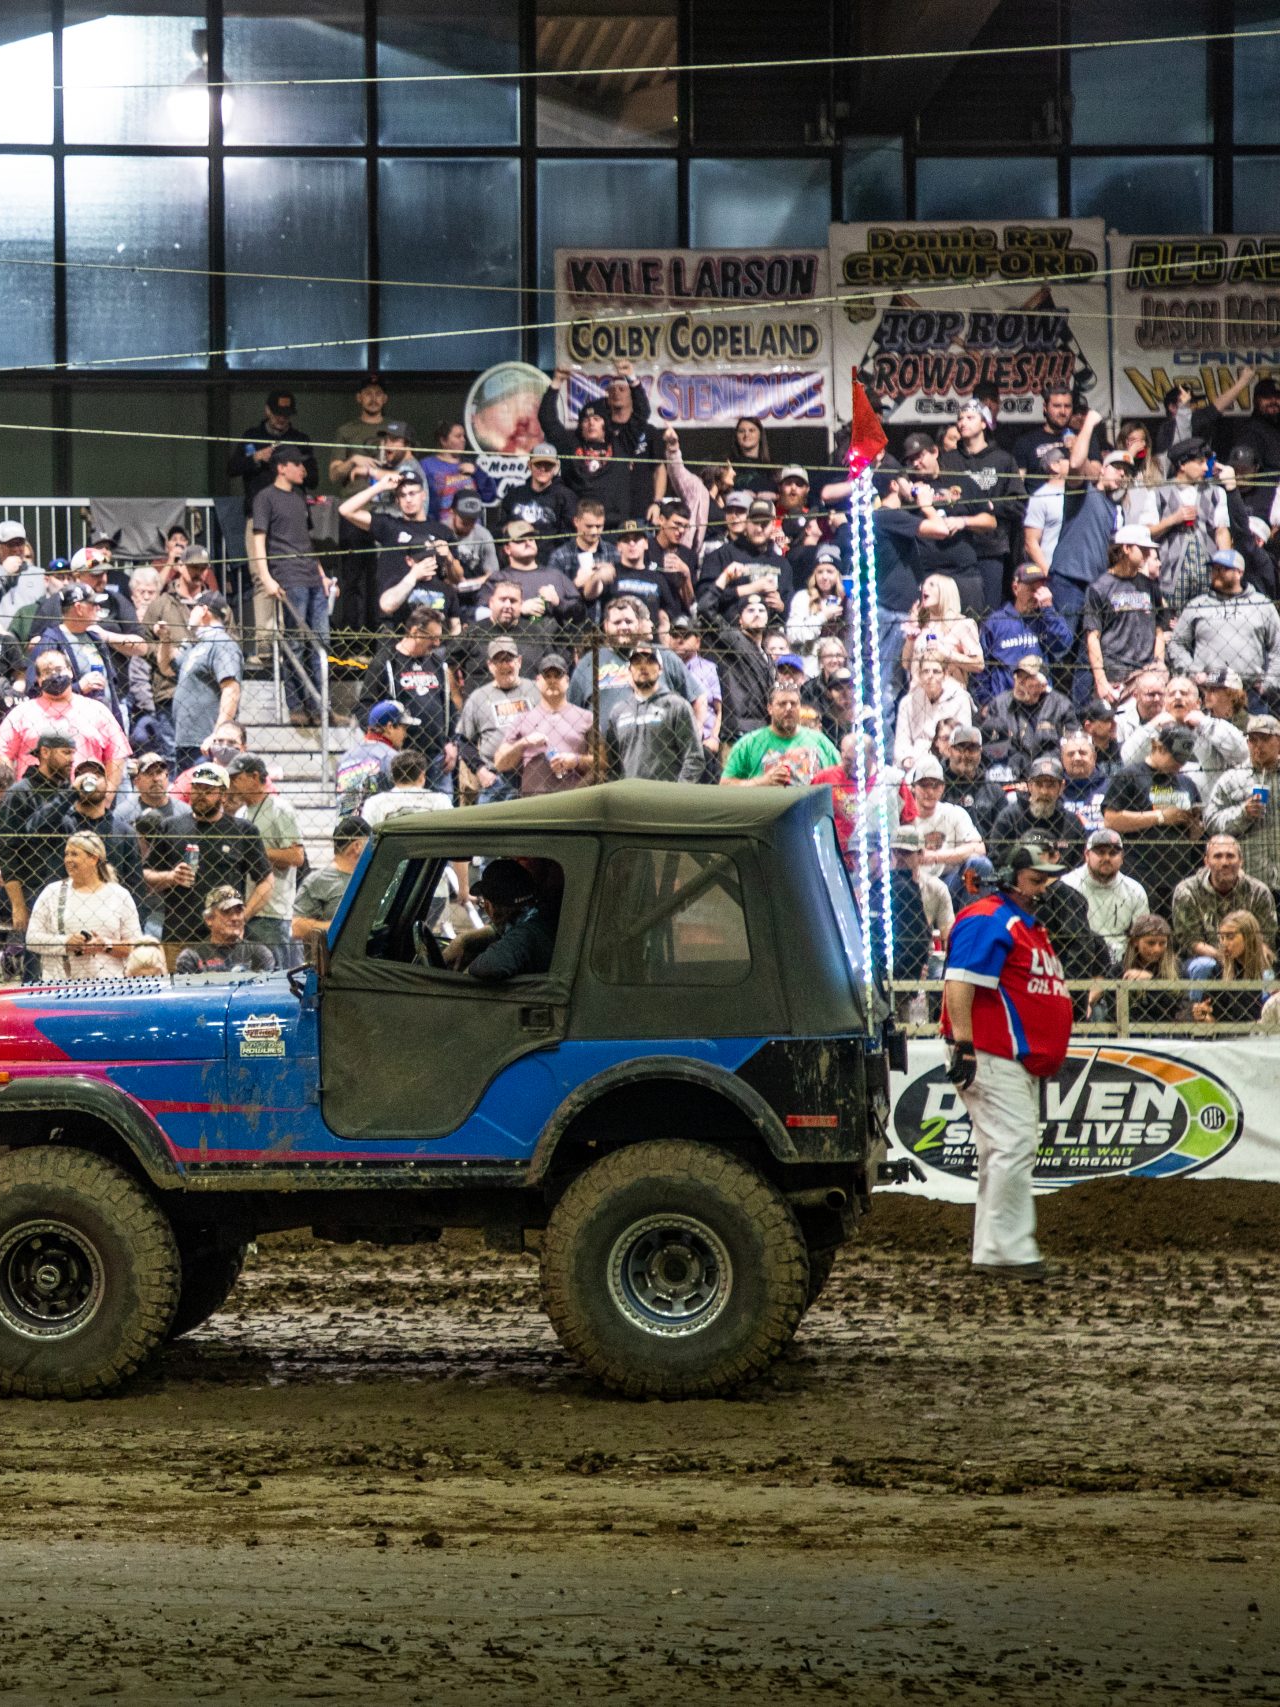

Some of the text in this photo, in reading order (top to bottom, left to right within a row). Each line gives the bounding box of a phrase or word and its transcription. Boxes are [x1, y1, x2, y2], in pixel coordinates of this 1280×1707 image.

[868, 226, 1073, 251] Donnie Ray
[568, 255, 820, 301] KYLE LARSON
[843, 250, 1099, 285] CRAWFORD
[1128, 240, 1227, 290] RICO
[569, 312, 821, 363] COLBY COPELAND
[882, 308, 1069, 350] TOP ROW
[1135, 295, 1221, 350] JASON
[657, 371, 826, 421] STENHOUSE
[921, 1081, 1180, 1121] DVEN
[943, 1146, 1135, 1157] RACI ND THE WAIT
[1054, 1122, 1173, 1145] LIVES
[1068, 1157, 1133, 1167] ORGANS
